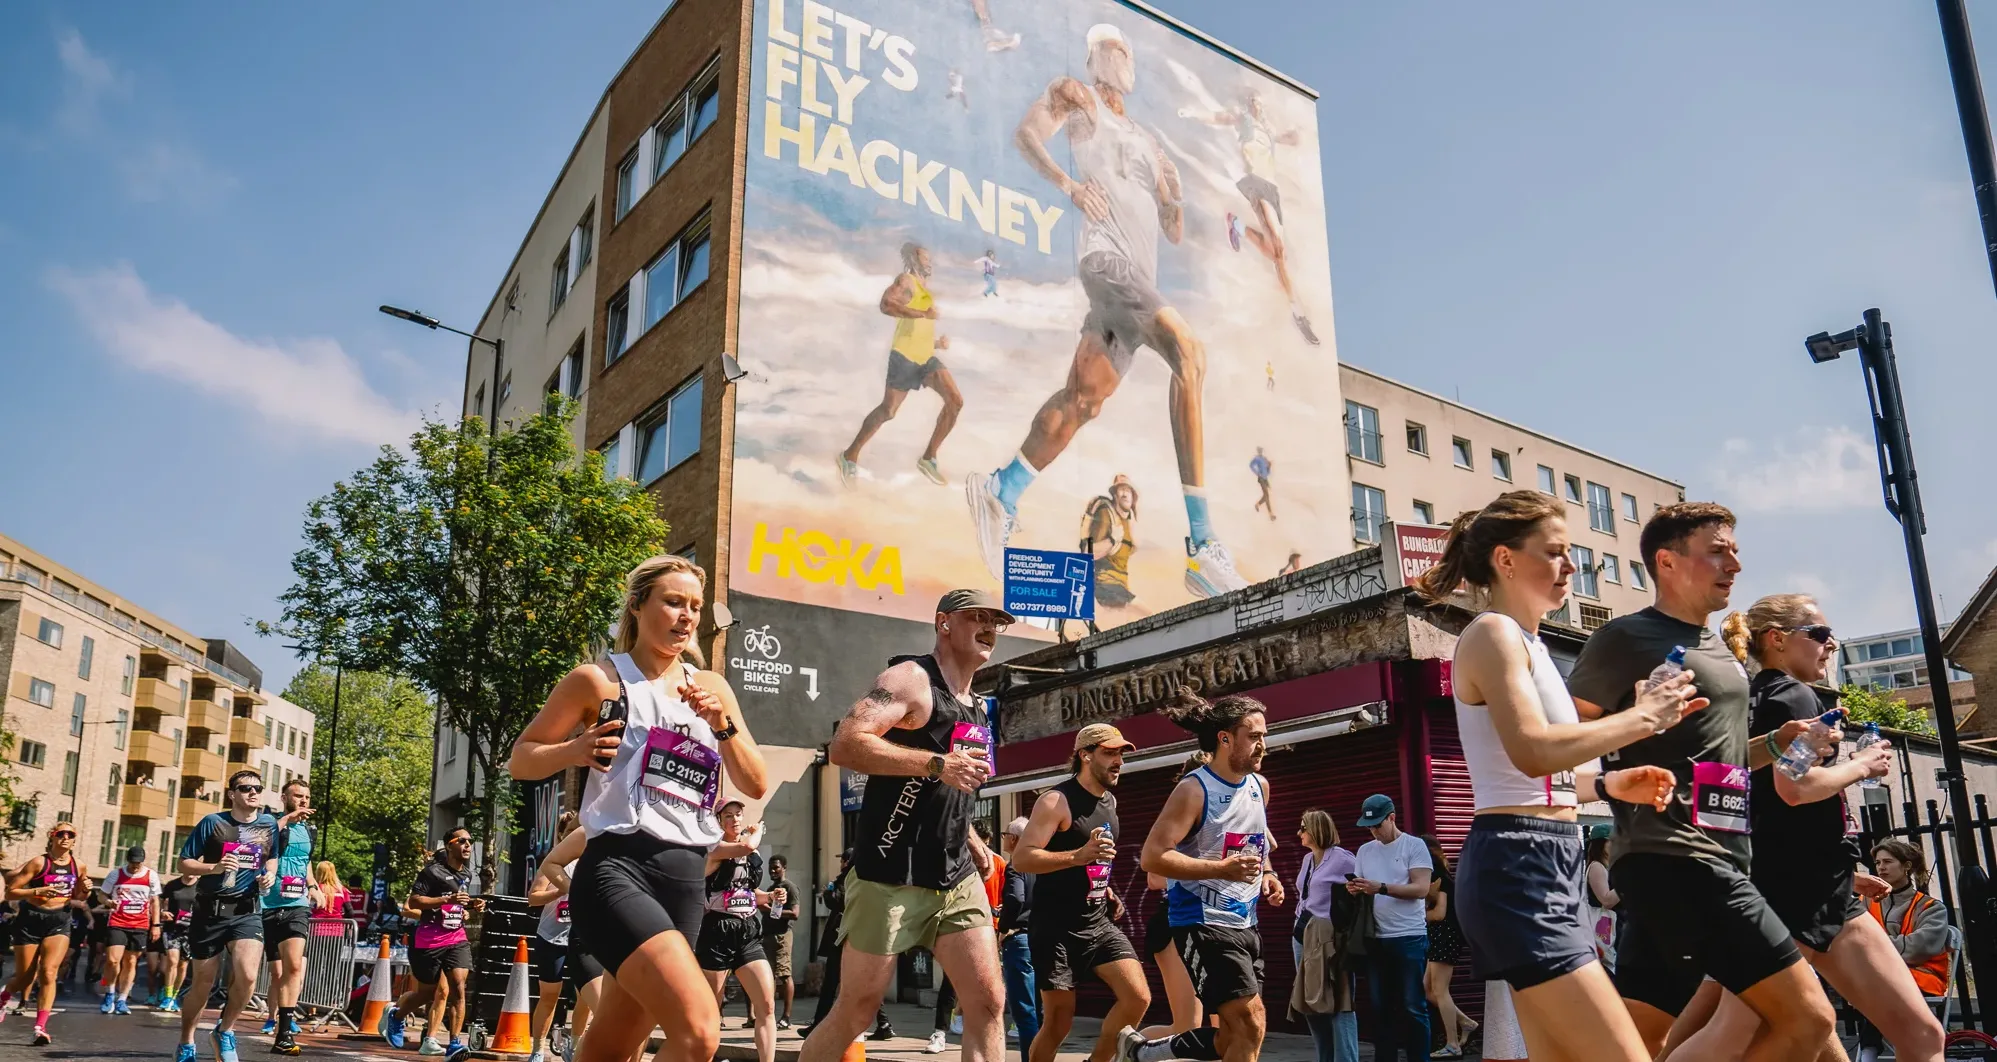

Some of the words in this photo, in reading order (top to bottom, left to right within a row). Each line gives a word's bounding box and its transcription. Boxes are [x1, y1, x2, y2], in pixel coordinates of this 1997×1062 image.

[768, 0, 918, 92] LET'S
[767, 42, 870, 125] FLY
[764, 100, 1064, 254] HACKNEY
[748, 522, 905, 595] HOKA
[1009, 554, 1042, 562] FREEHOLD
[1009, 561, 1055, 570] DEVELOPMENT
[1009, 568, 1053, 577] OPPORTUNITY
[1010, 586, 1031, 596] FOR
[1032, 588, 1057, 597] SALE
[1010, 602, 1026, 611] 020
[1027, 603, 1045, 611] 7377
[730, 657, 792, 675] CLIFFORD
[743, 670, 780, 685] BIKES
[743, 684, 762, 693] CYCLE
[763, 685, 780, 694] CAFE
[1060, 664, 1203, 722] BUNGALOWS
[666, 760, 676, 773] C
[677, 764, 708, 785] 21137
[1708, 792, 1720, 807] B
[877, 777, 925, 859] ARC'TERY
